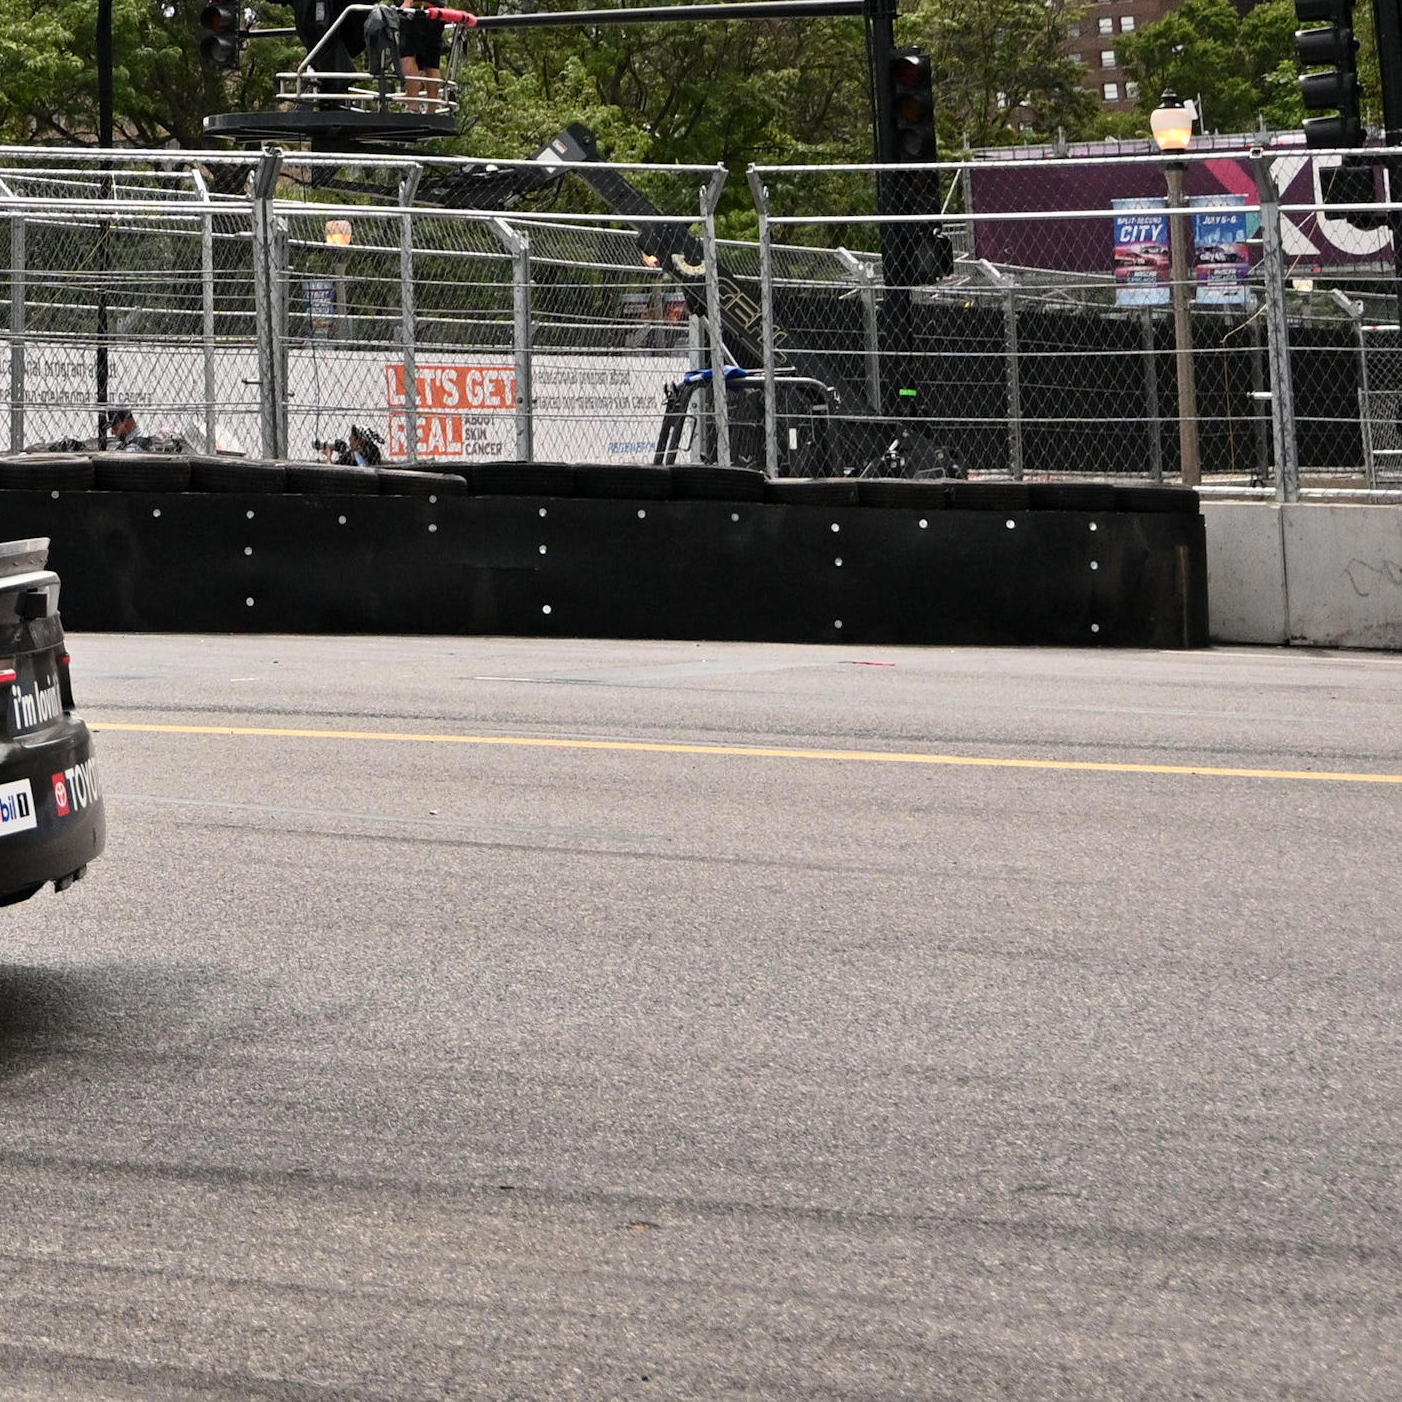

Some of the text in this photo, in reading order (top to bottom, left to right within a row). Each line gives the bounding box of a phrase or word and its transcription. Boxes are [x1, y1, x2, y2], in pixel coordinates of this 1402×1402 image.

[1119, 224, 1163, 242] CITY
[465, 369, 516, 406] GET
[465, 442, 502, 456] CANCER
[11, 684, 37, 729] i'm
